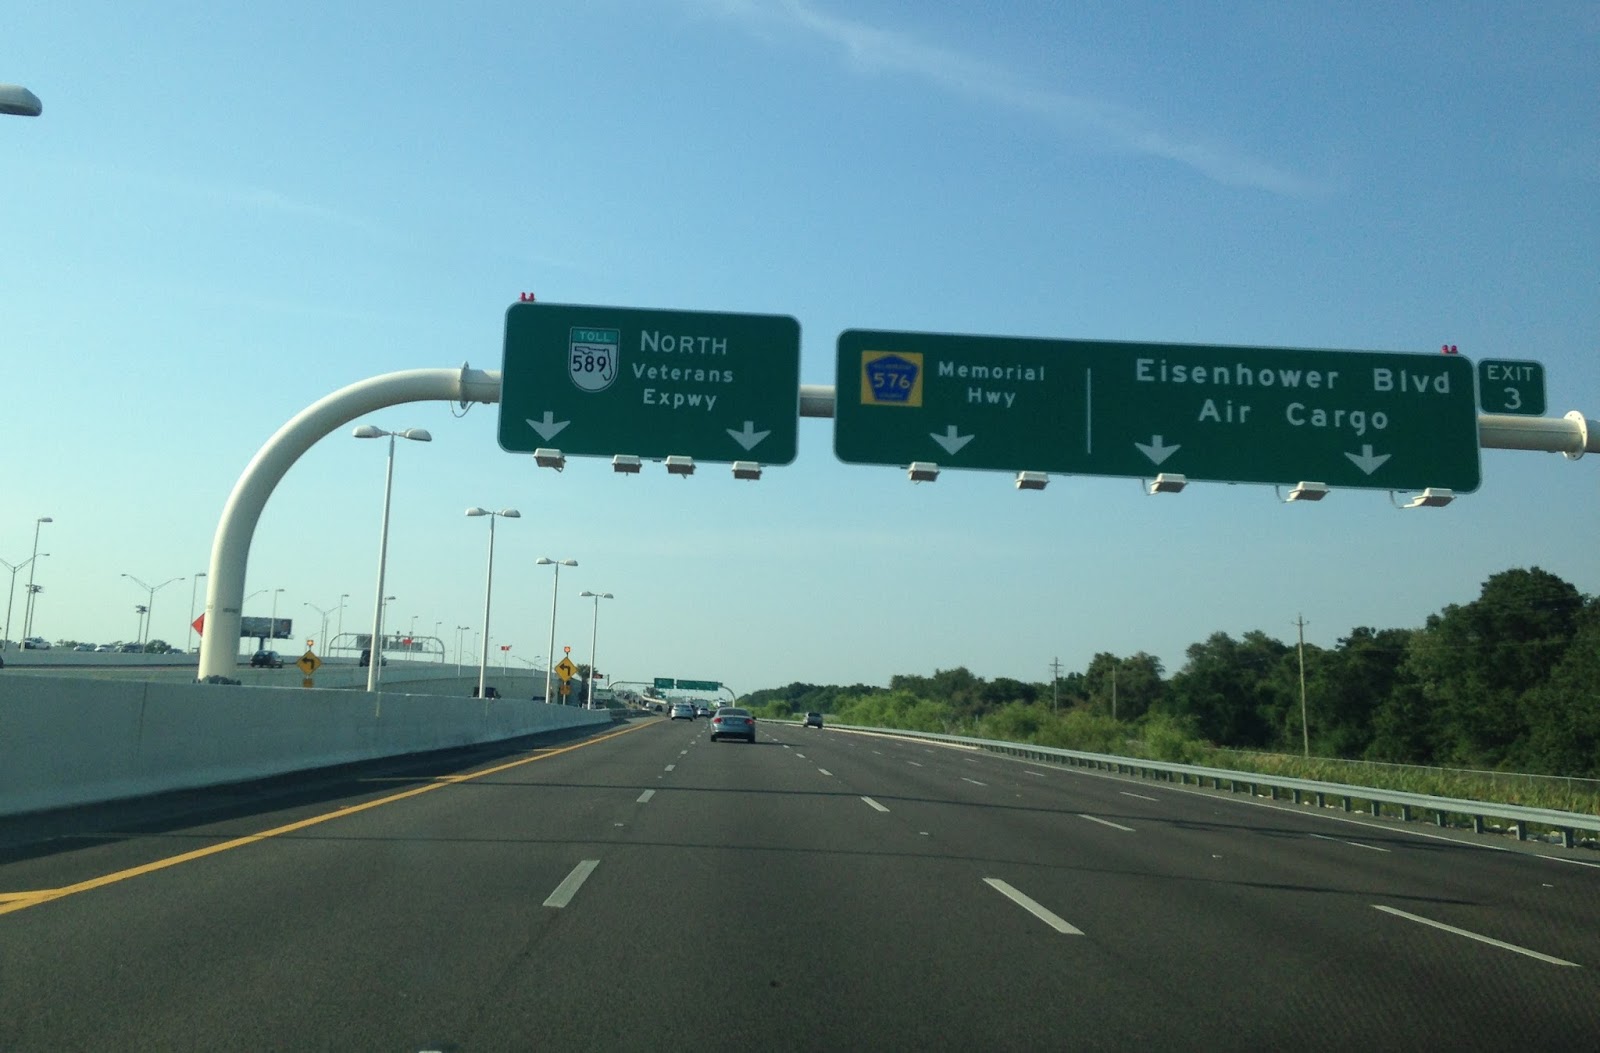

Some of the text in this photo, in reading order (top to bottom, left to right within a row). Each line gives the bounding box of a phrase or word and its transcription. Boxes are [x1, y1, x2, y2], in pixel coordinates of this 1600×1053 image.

[579, 331, 610, 341] TOLL
[572, 355, 606, 373] 589
[632, 363, 733, 382] Veterans
[938, 361, 1045, 381] Memorial
[1487, 365, 1533, 382] EXIT
[874, 373, 910, 389] 576
[1136, 358, 1450, 394] Eisenhower Blvd
[643, 388, 717, 411] Expwy
[968, 387, 1016, 408] Hwy
[1504, 388, 1521, 409] 3
[1198, 399, 1388, 436] Air Cargo
